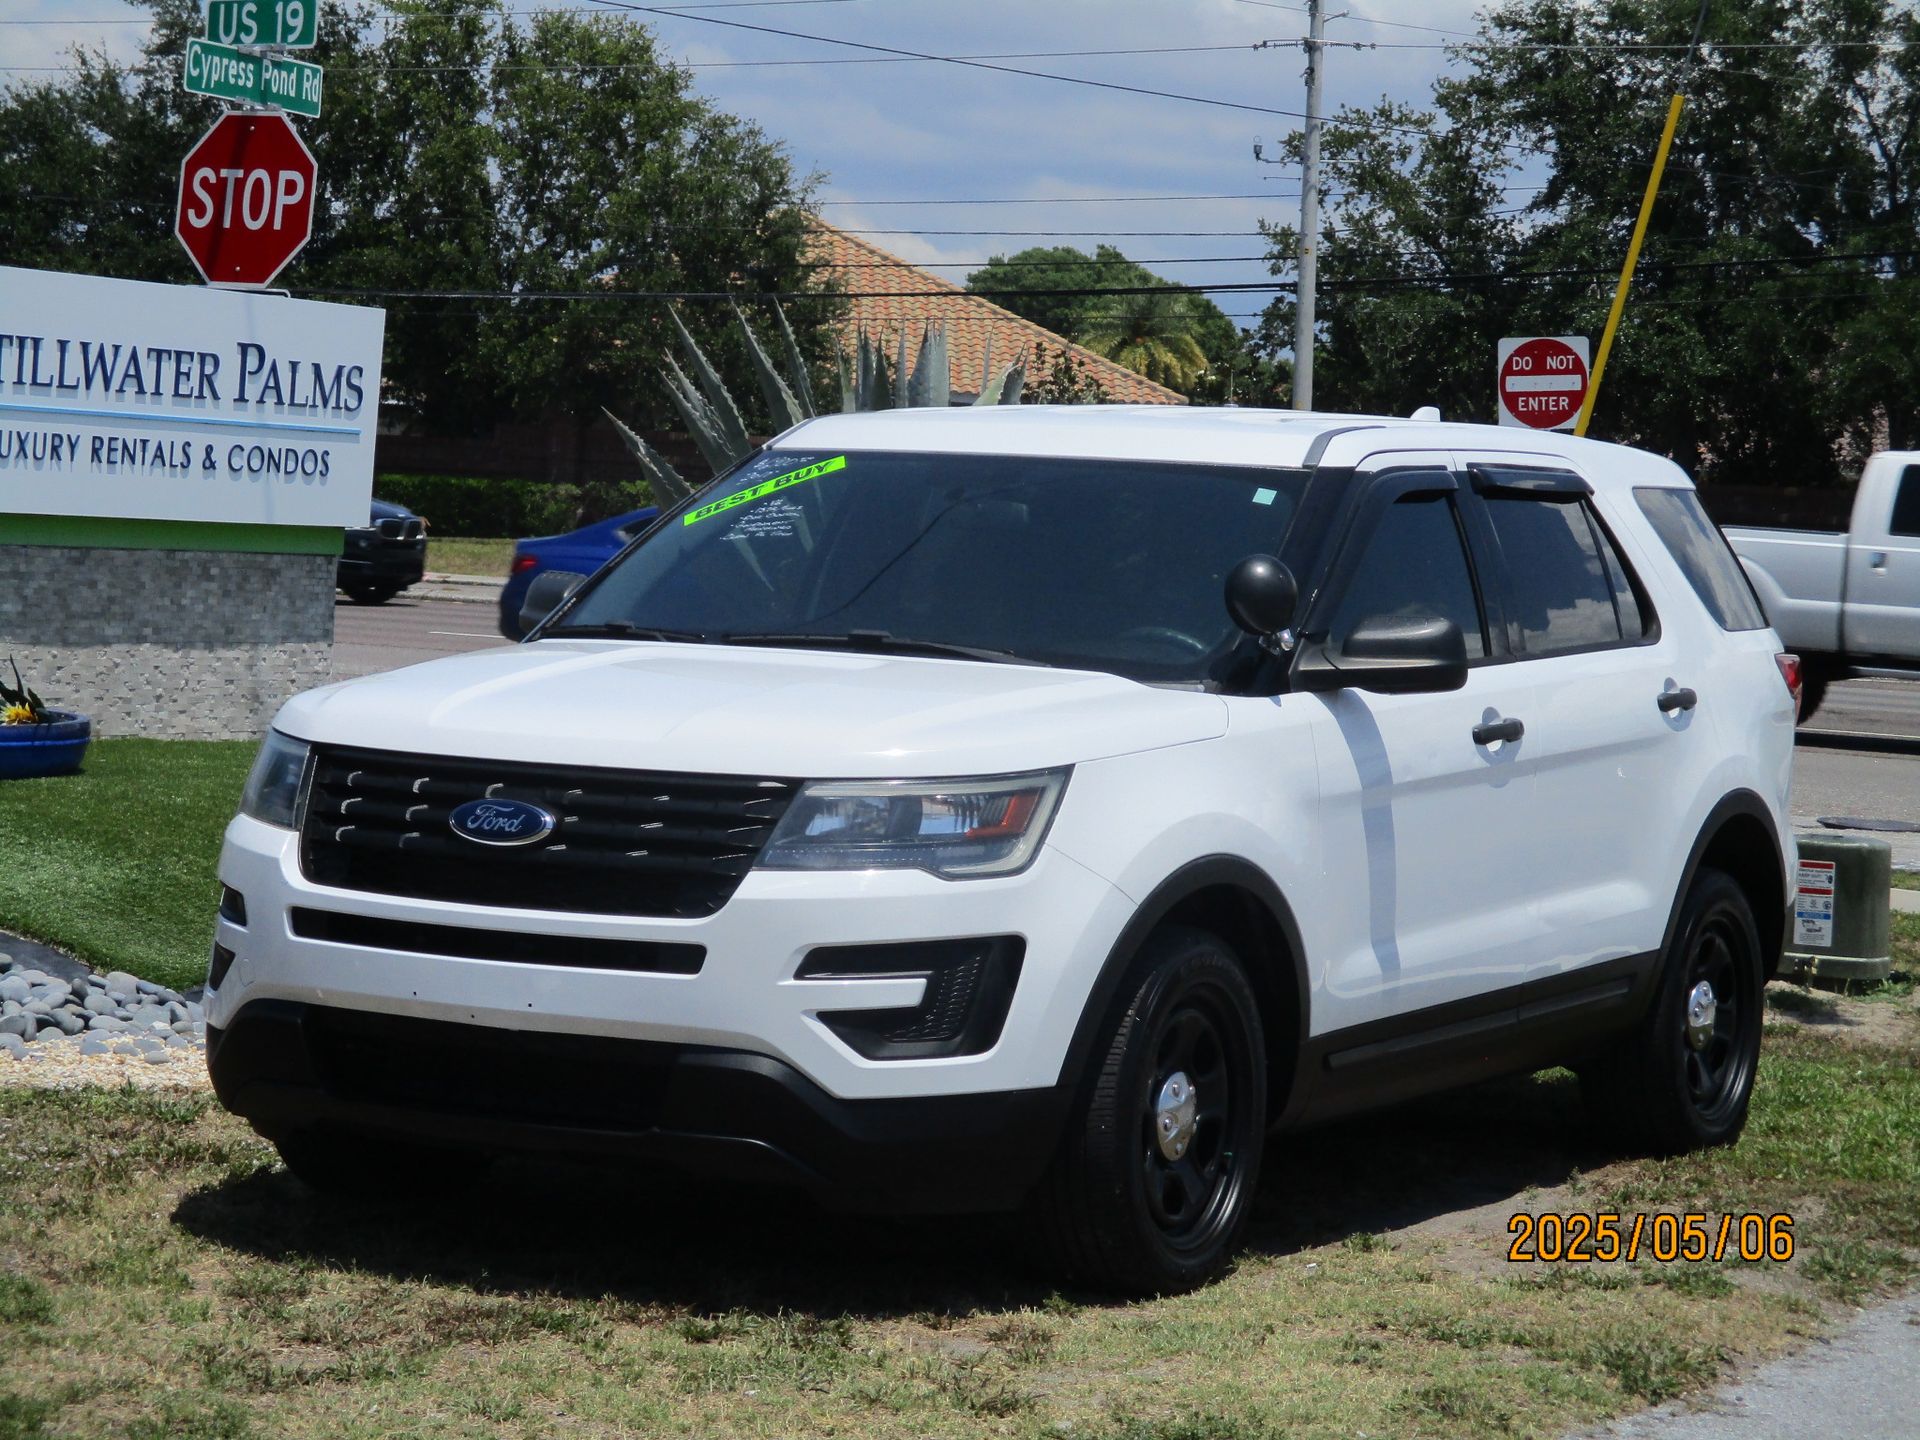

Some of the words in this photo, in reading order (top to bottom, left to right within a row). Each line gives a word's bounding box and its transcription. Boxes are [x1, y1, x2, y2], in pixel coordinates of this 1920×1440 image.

[218, 2, 258, 45] US
[275, 2, 304, 44] 19
[189, 50, 254, 89] Cypress
[260, 59, 297, 98] Pond
[302, 69, 321, 103] Rd
[187, 166, 305, 231] STOP
[233, 342, 364, 412] PALMS
[1512, 356, 1533, 371] DO
[1546, 355, 1575, 370] NOT
[1517, 396, 1569, 412] ENTER
[0, 429, 80, 463] UXURY
[90, 435, 192, 470] RENTALS
[202, 444, 217, 471] &
[228, 444, 331, 477] CONDOS
[694, 484, 768, 519] BEST
[773, 460, 836, 489] BUY
[466, 804, 526, 833] Ford
